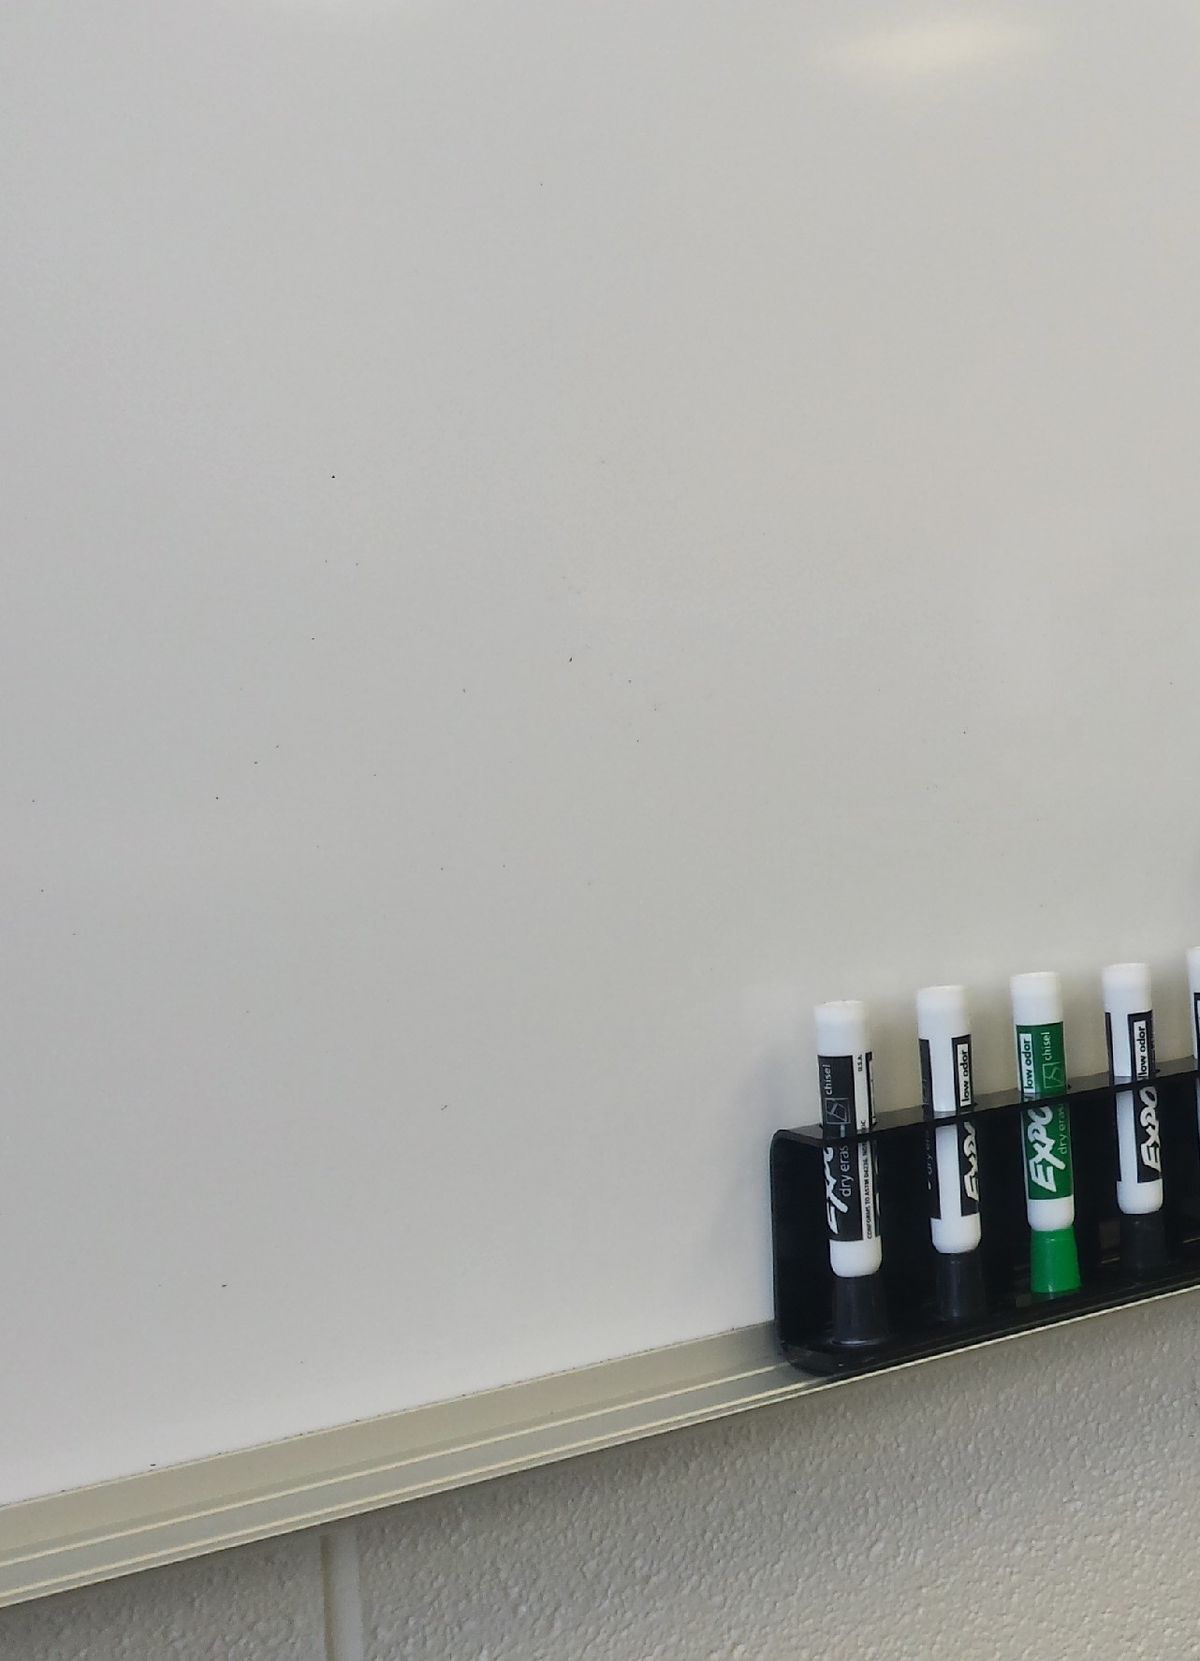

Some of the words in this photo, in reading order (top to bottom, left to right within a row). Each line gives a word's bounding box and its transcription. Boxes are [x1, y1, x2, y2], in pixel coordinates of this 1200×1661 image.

[1020, 1038, 1032, 1066] odor
[1040, 1032, 1052, 1061] chisel
[1137, 1026, 1146, 1052] odor
[959, 1049, 969, 1077] odor
[1138, 1054, 1147, 1075] low
[822, 1064, 832, 1095] chisel
[961, 1080, 970, 1101] low
[1022, 1068, 1033, 1090] low
[1058, 1104, 1066, 1131] eras
[1140, 1086, 1161, 1173] EXPO
[1058, 1133, 1068, 1154] dry
[839, 1145, 850, 1172] eras
[839, 1174, 854, 1197] dry
